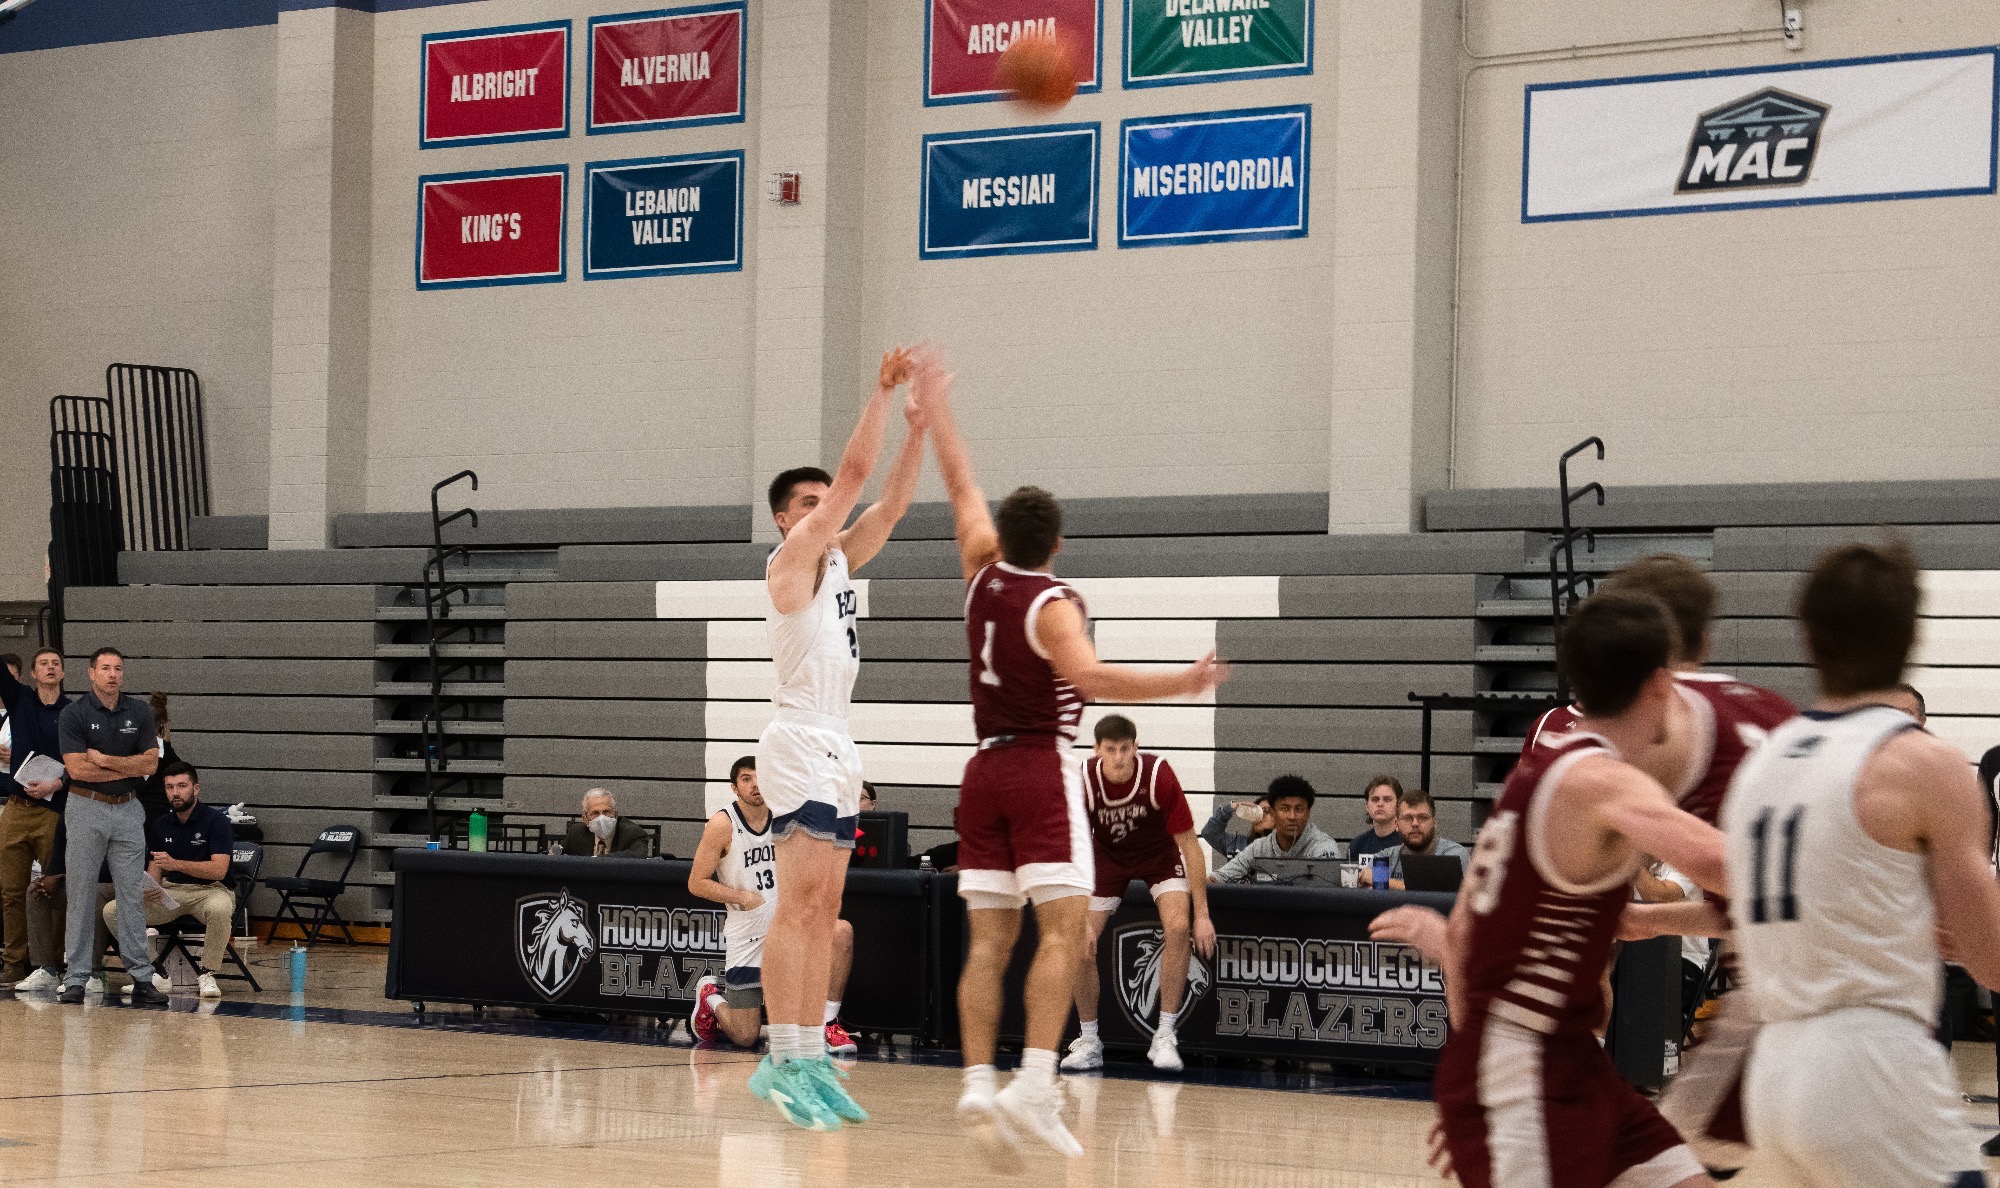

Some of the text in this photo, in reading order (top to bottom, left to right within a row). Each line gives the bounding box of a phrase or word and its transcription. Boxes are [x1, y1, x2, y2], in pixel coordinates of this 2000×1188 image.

[1181, 14, 1254, 48] VALLEY
[450, 68, 539, 103] ALBRIGHT
[620, 51, 711, 87] ALVERNIA
[1133, 156, 1295, 198] MISERICORDIA
[1686, 137, 1809, 184] MAC
[625, 187, 701, 217] LEBANON
[962, 173, 1056, 209] MESSIAH
[461, 213, 522, 244] KING'S
[632, 217, 693, 246] VALLEY
[979, 621, 1003, 687] 1
[1750, 803, 1806, 925] 11
[598, 904, 728, 954] HOOD COLL
[600, 953, 728, 1001] BLAZ
[1216, 935, 1446, 995] HOOD COLLEGE
[1216, 988, 1448, 1049] BLAZERS
